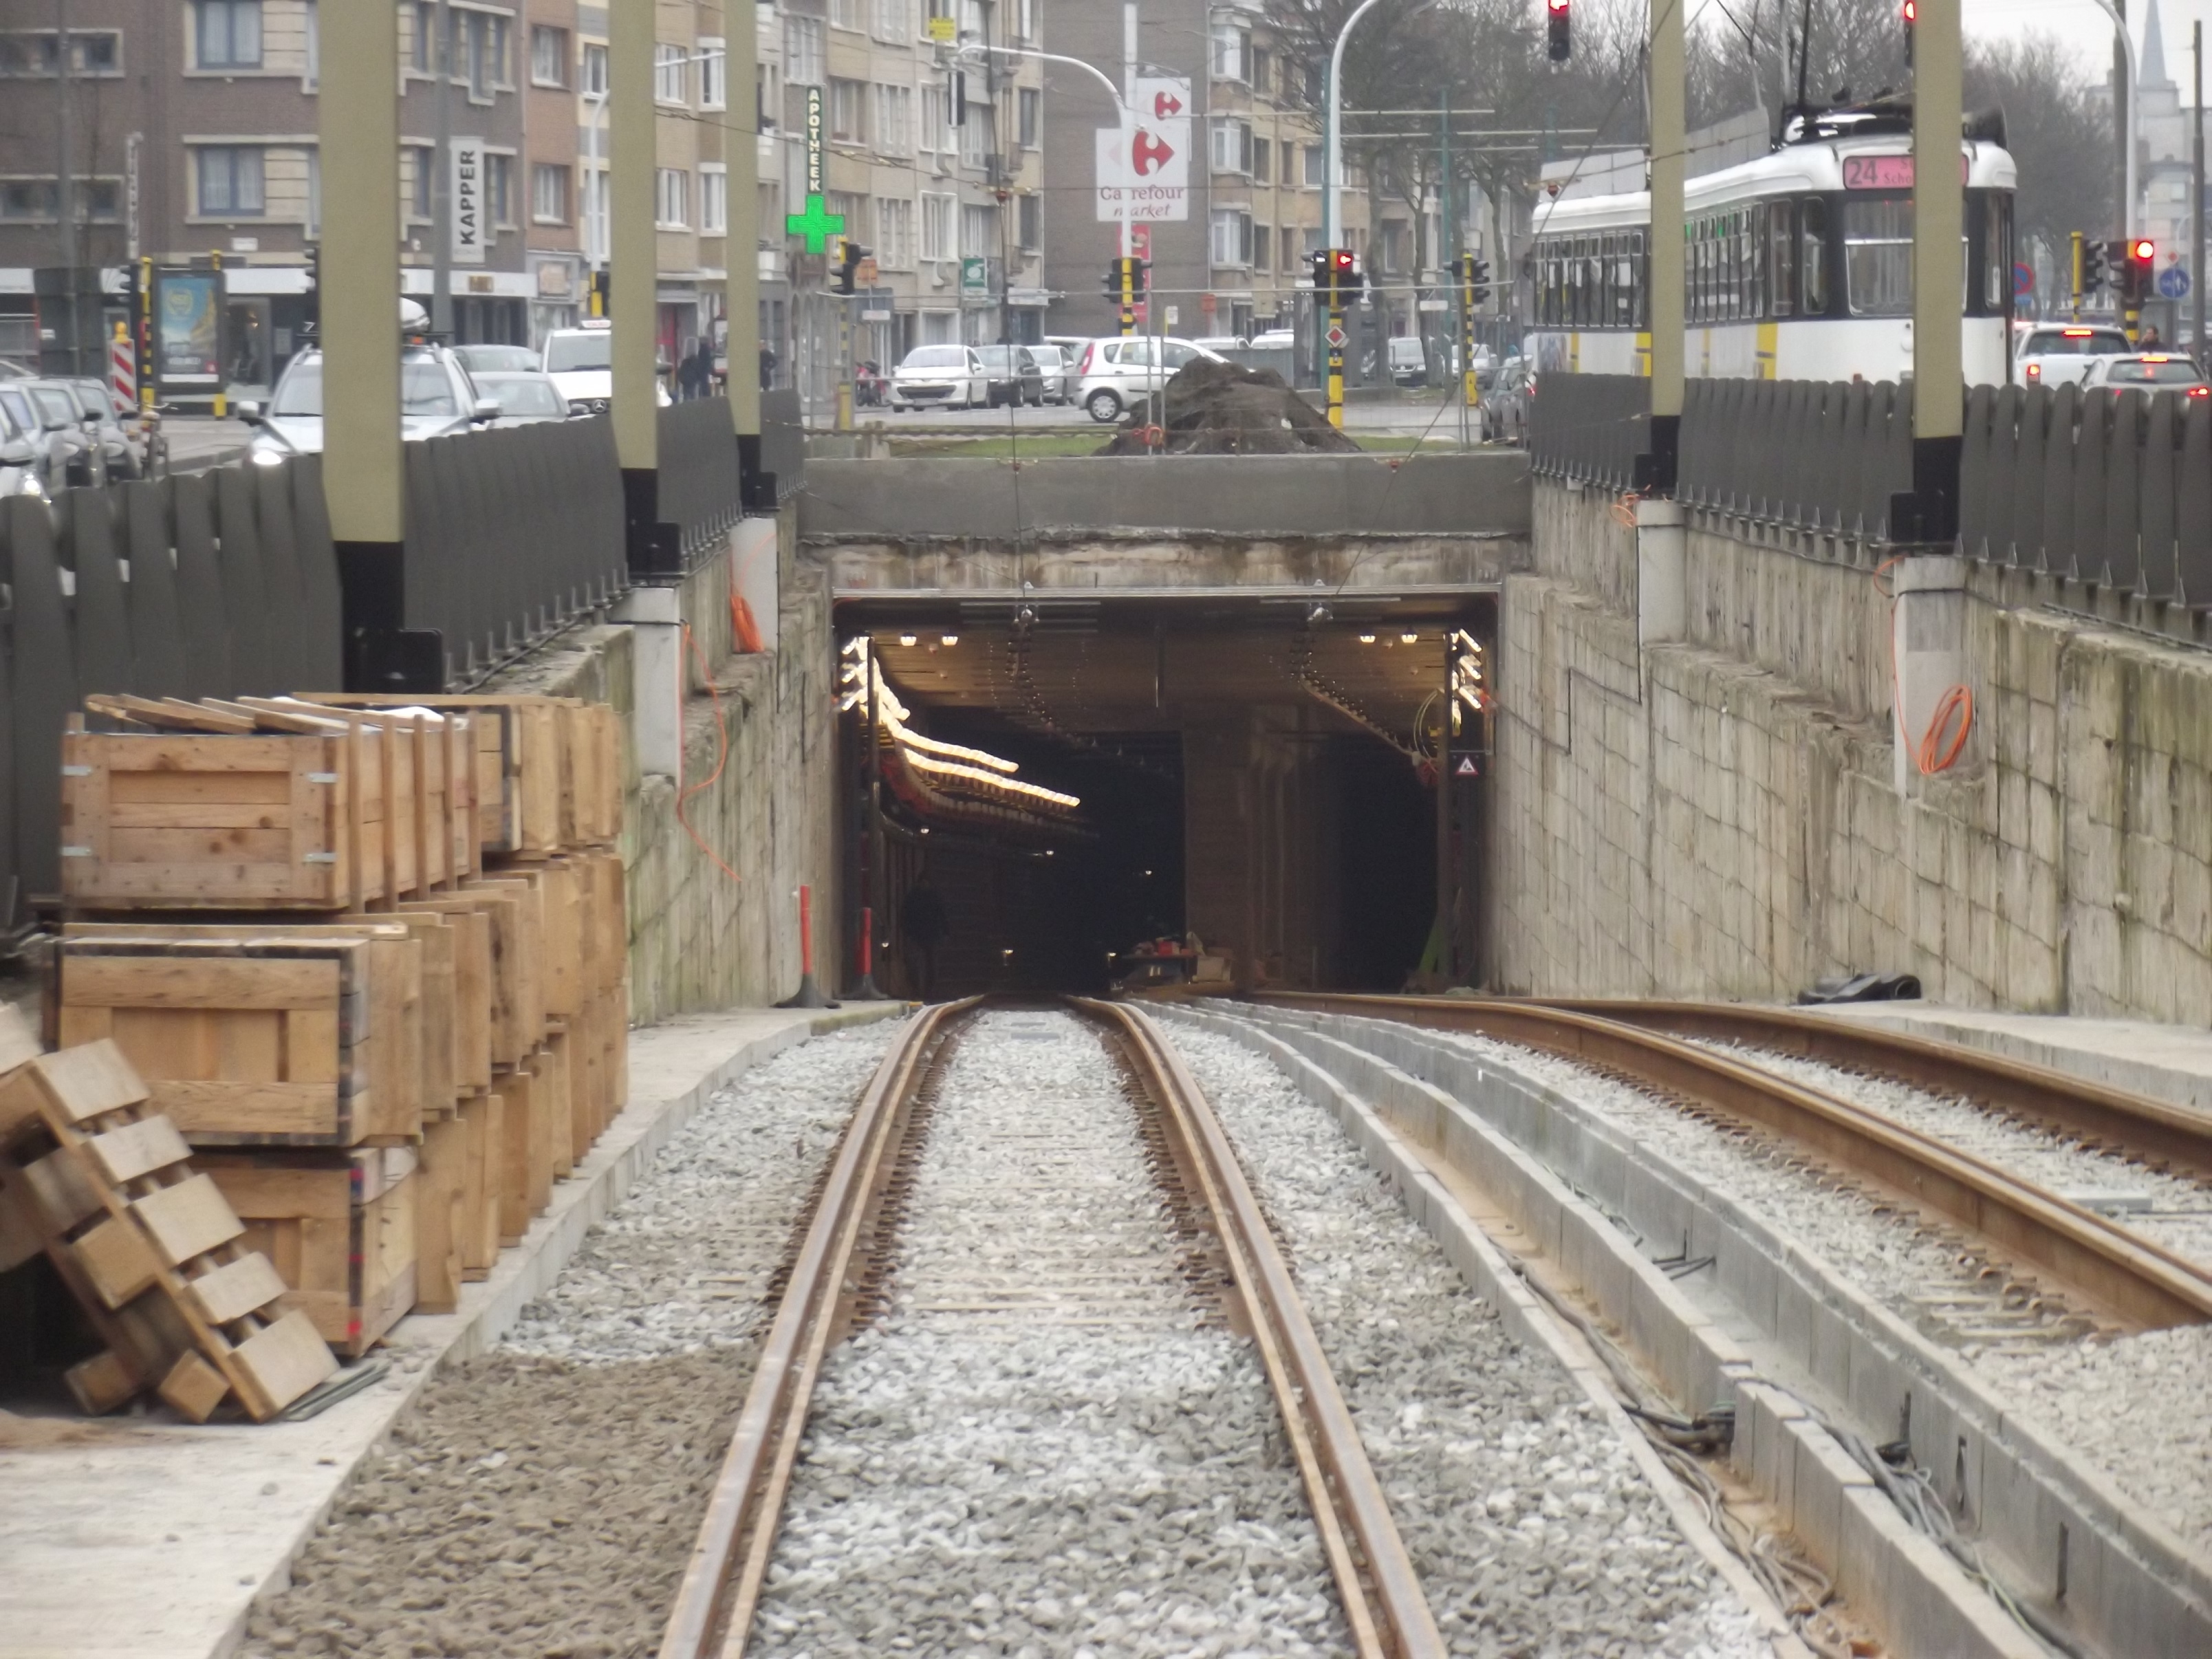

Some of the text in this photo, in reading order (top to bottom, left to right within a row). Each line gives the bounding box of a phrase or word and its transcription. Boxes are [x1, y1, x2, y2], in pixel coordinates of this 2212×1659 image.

[808, 89, 821, 192] APOTHEEK
[460, 150, 475, 245] KAPPER
[1100, 184, 1184, 201] Carefour
[1848, 159, 1878, 185] 24
